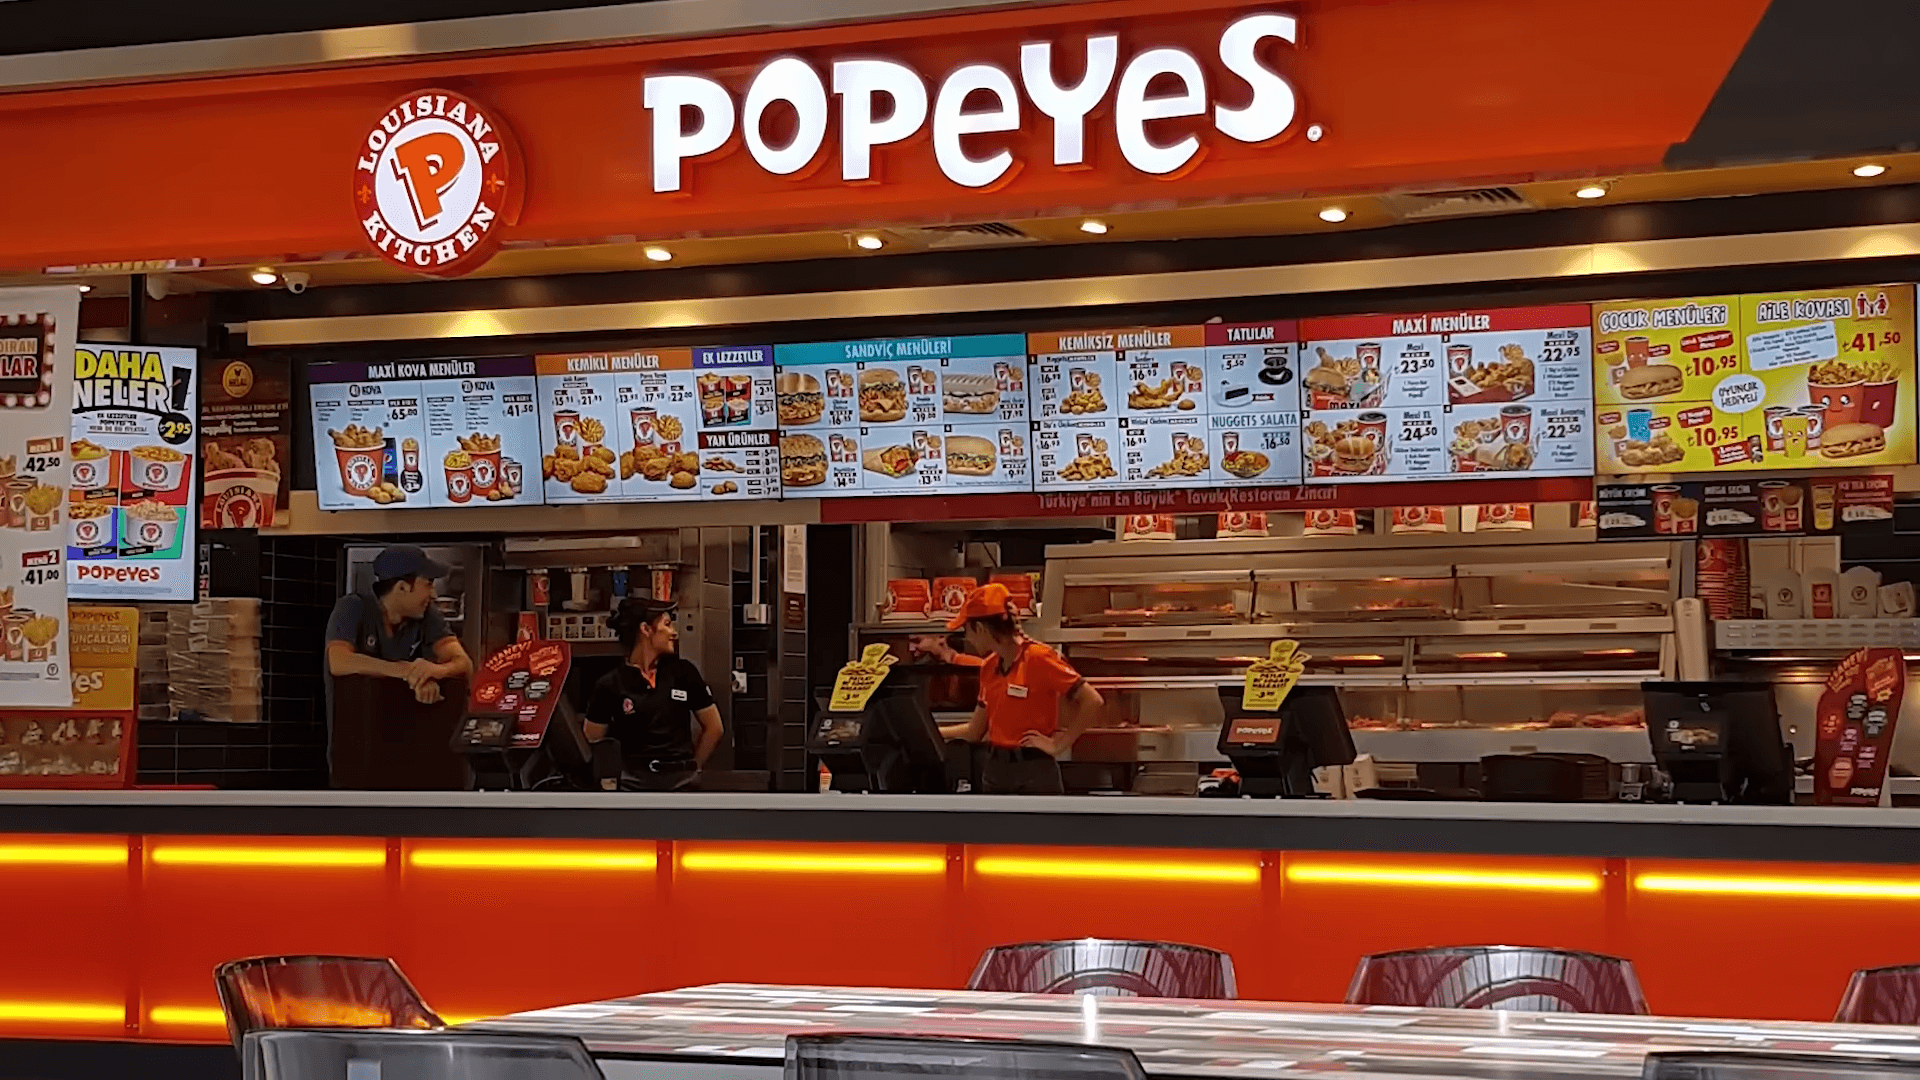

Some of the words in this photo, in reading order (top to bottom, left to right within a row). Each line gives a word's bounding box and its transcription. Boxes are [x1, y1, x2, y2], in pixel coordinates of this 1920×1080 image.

[357, 95, 500, 174] LOUISIANA
[363, 201, 496, 266] KITCHEN
[1600, 309, 1648, 331] ÇOCUK
[1652, 302, 1727, 328] MENÜLERİ
[1757, 301, 1790, 322] AİLE
[1793, 299, 1851, 318] KOVASI
[1430, 312, 1490, 332] MENÜLER
[1059, 331, 1114, 351] KEMİKSİZ
[1117, 329, 1172, 348] MENÜLER
[1227, 326, 1275, 341] TATLILAR
[702, 351, 715, 365] EK
[716, 349, 764, 364] LEZZETLER
[844, 341, 894, 360] SANDVİÇ
[896, 338, 952, 356] MENÜLERİ
[74, 350, 165, 382] DAHA
[397, 362, 428, 379] KOVA
[428, 359, 476, 378] MENÜLER
[567, 355, 609, 372] KEMİKLİ
[611, 352, 660, 370] MENÜLER
[1211, 415, 1258, 427] NUGGETS
[1260, 413, 1297, 425] SALATA
[706, 434, 726, 447] YAN
[727, 431, 771, 447] ÜRÜNLER
[1038, 493, 1111, 513] Türkiye'nin
[1114, 490, 1130, 507] En
[1186, 489, 1224, 505] Tavuk
[1229, 488, 1291, 503] Restoran
[1295, 485, 1338, 501] Zinciri
